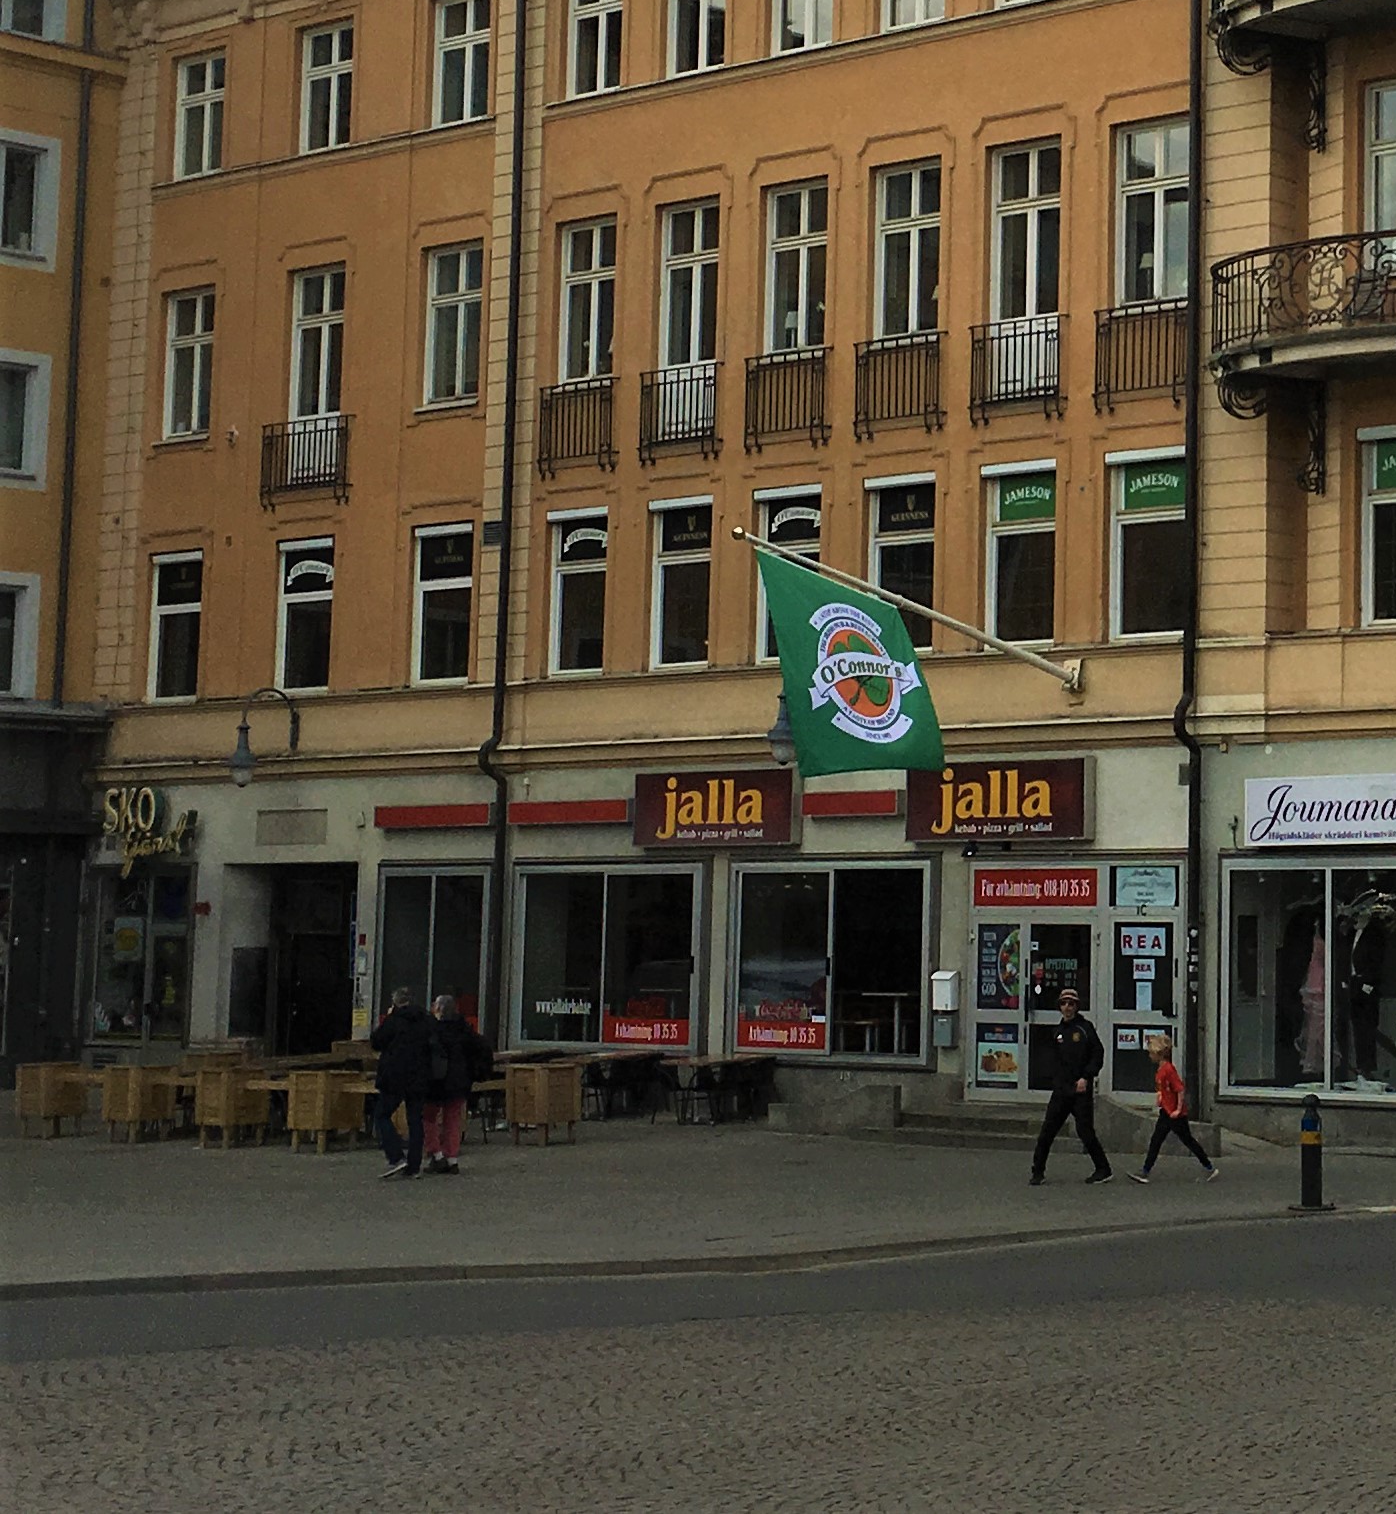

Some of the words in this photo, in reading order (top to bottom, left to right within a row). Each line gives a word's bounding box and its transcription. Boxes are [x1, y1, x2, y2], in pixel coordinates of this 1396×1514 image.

[1129, 473, 1180, 493] JAMESON
[1004, 486, 1051, 505] JAMESON
[820, 658, 904, 684] O'Connor's
[655, 776, 763, 839] jalla
[931, 767, 1053, 834] jalla
[102, 787, 156, 834] SKO
[701, 828, 718, 840] pizza
[723, 828, 737, 840] grill
[954, 822, 977, 833] kebab
[982, 822, 1002, 835] pizza
[1008, 822, 1024, 835] grill
[981, 879, 994, 897] För
[1043, 879, 1068, 897] 018-10
[1069, 879, 1079, 897] 35
[1080, 879, 1090, 897] 35
[1123, 935, 1162, 949] REA
[1134, 963, 1152, 973] REA
[661, 1023, 669, 1039] 35
[669, 1023, 678, 1039] 35
[789, 1027, 797, 1043] 10
[798, 1027, 806, 1043] 35
[807, 1027, 816, 1044] 35
[1118, 1033, 1136, 1043] REA
